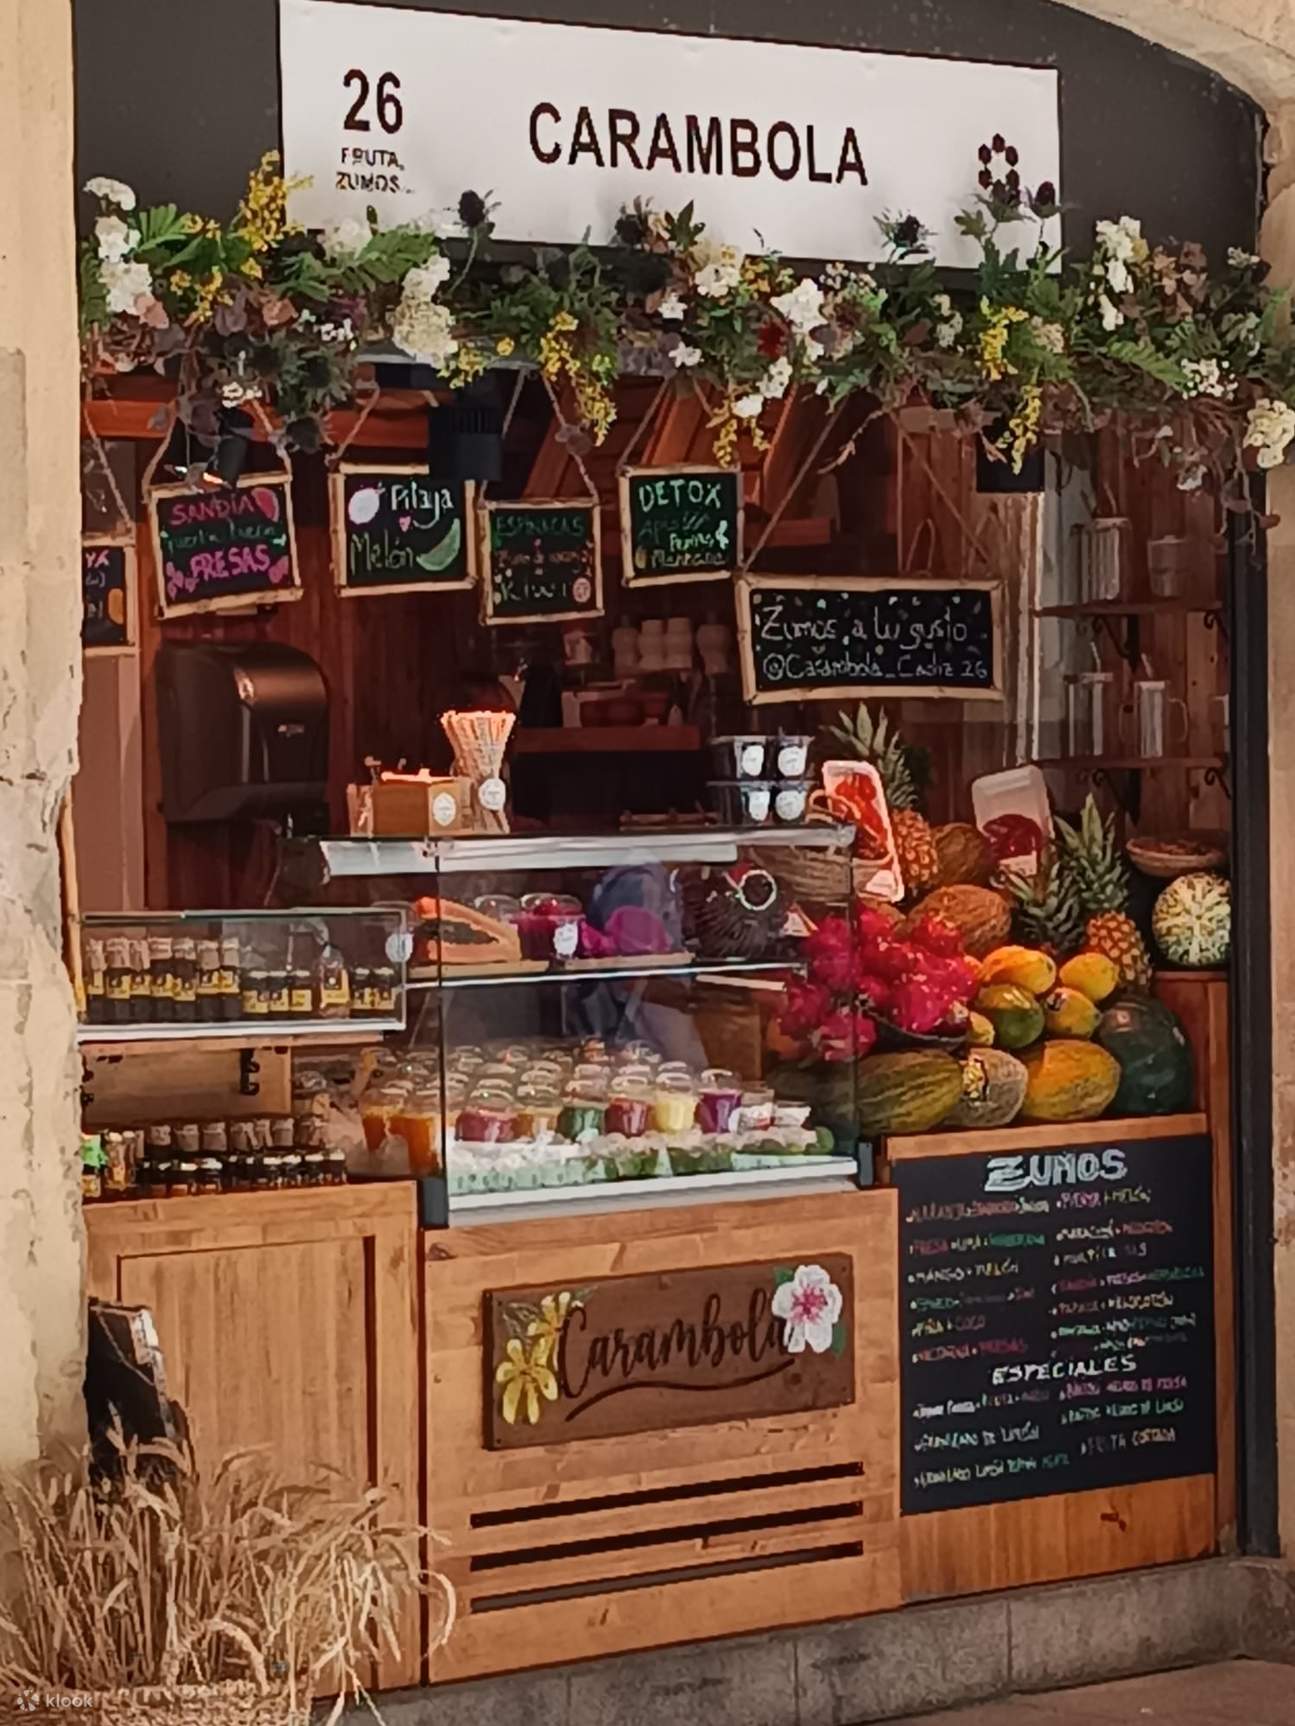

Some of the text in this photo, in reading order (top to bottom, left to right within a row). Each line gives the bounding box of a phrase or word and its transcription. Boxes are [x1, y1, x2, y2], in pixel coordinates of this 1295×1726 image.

[343, 69, 403, 134] 26
[529, 102, 868, 186] CARAMBOLA
[638, 479, 721, 512] DETOX
[190, 544, 270, 581] FRESAS
[761, 604, 838, 641] Zumos
[851, 619, 868, 640] a
[983, 1148, 1129, 1192] ZUMOS
[992, 1353, 1138, 1386] ESPECIALES
